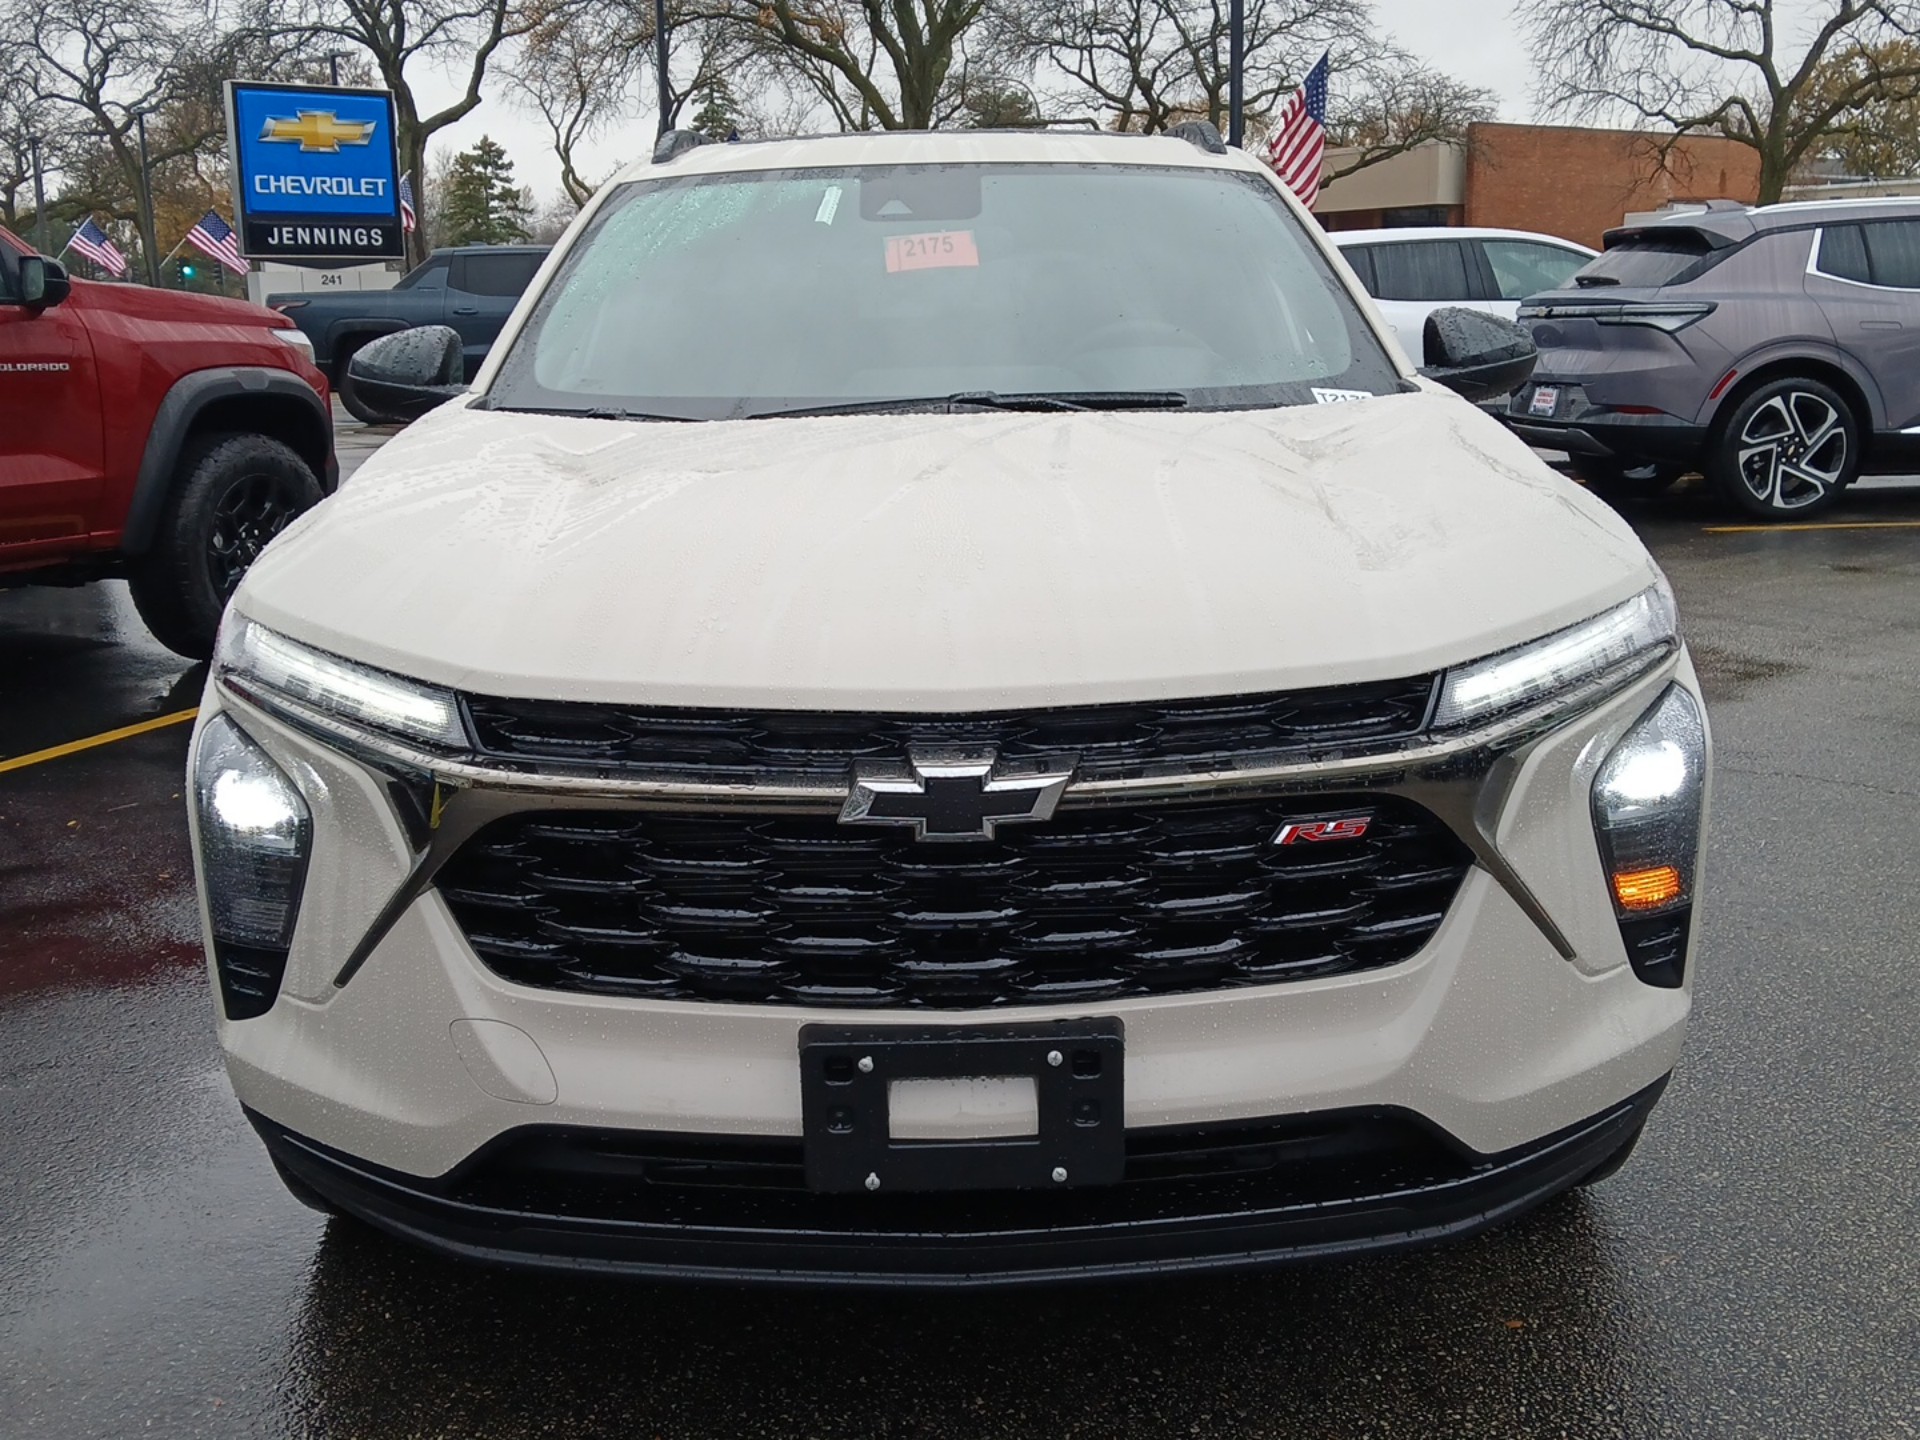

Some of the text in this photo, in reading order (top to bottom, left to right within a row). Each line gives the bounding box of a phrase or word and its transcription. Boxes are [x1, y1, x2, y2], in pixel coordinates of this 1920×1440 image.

[254, 175, 387, 196] CHEVROLET
[267, 227, 384, 246] JENNINGS
[904, 237, 954, 257] 2175
[321, 274, 342, 285] 241
[1273, 817, 1371, 845] RS
